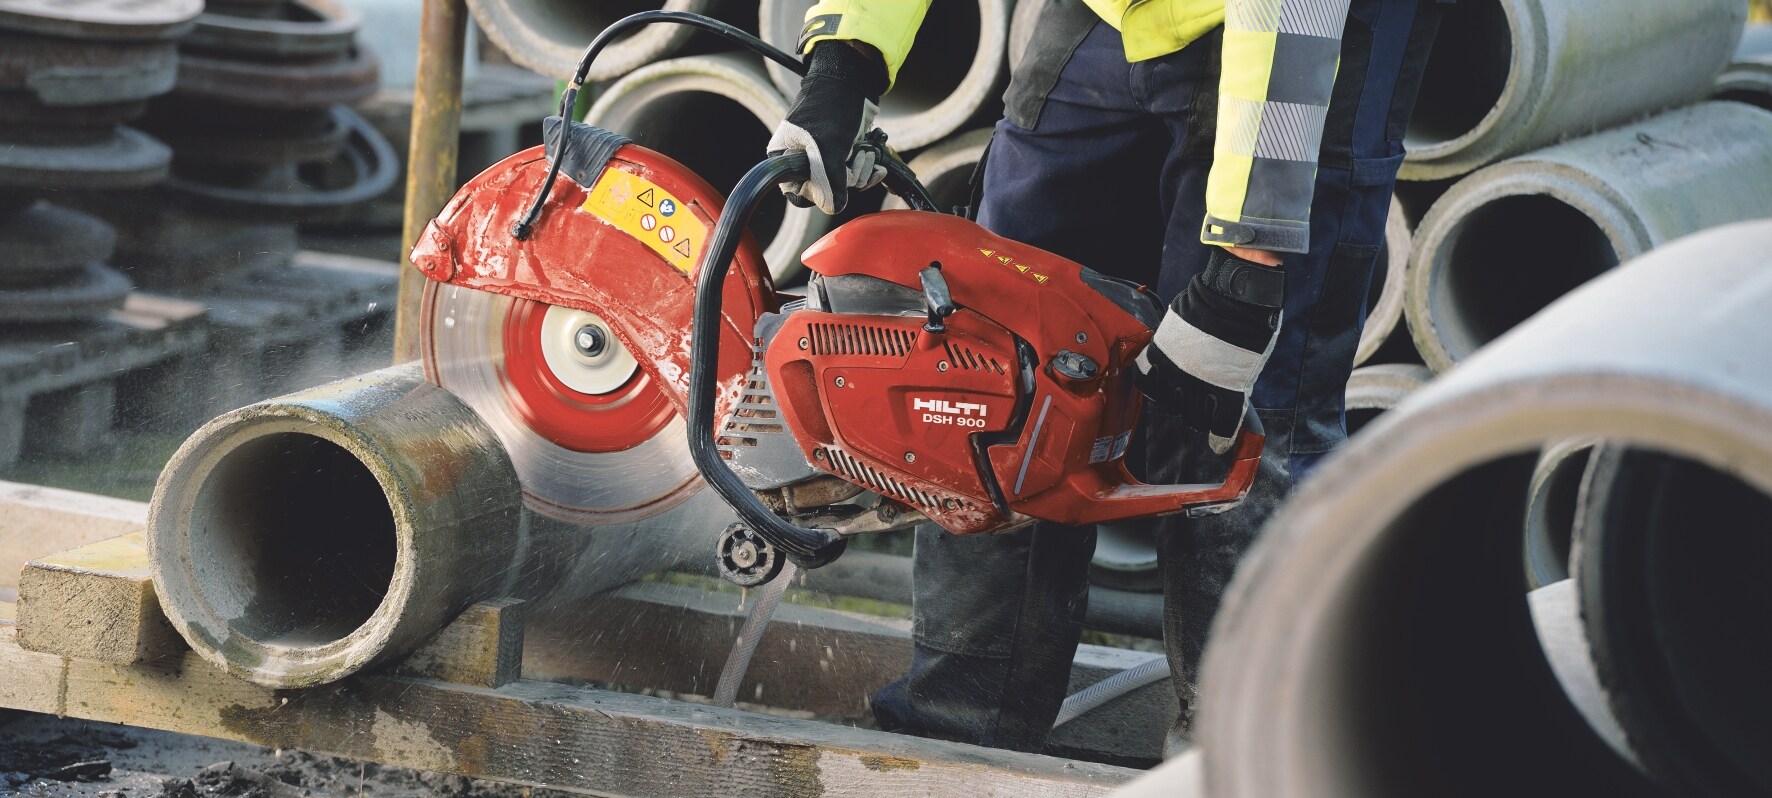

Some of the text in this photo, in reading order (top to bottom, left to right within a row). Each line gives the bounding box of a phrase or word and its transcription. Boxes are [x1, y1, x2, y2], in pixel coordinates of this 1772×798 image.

[914, 398, 987, 416] HILTI
[923, 413, 986, 428] DSH 900
